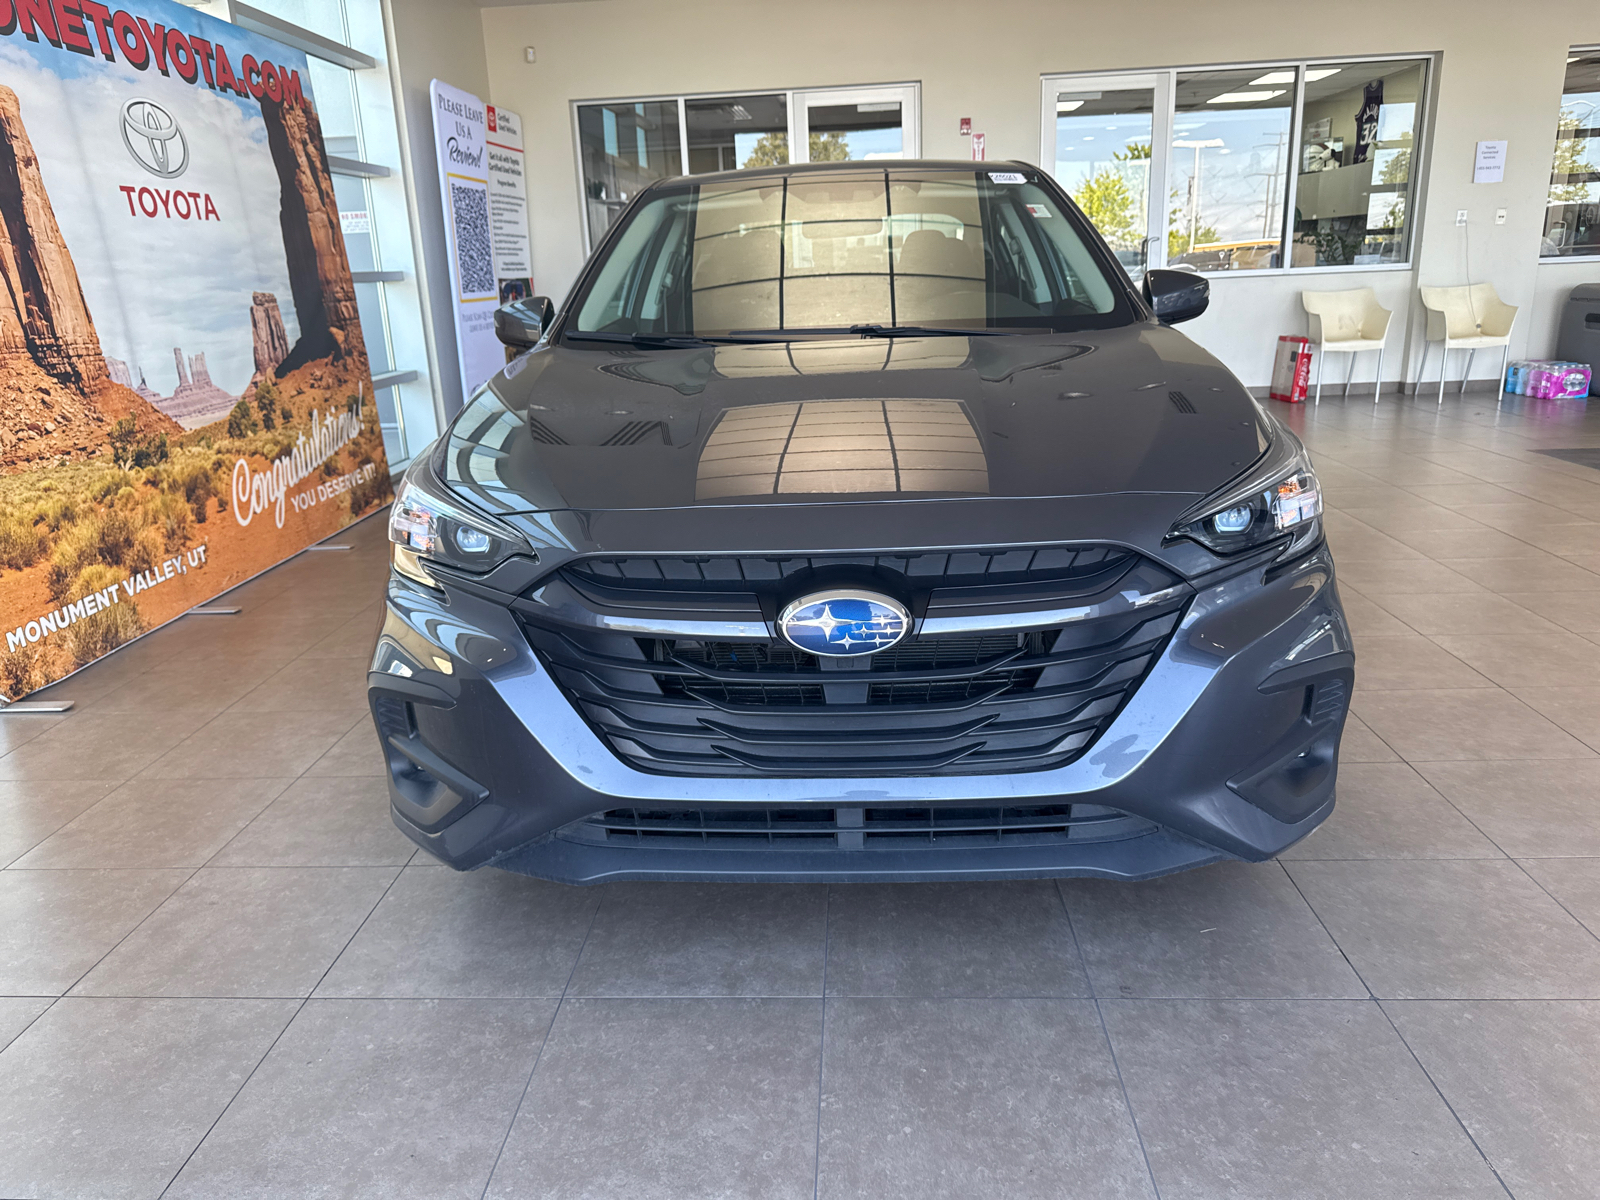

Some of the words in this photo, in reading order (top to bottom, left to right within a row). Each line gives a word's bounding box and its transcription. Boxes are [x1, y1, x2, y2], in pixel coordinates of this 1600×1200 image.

[0, 0, 305, 109] NETOYOTA.COM
[438, 93, 463, 118] PLEASE
[464, 103, 483, 124] LEAVE
[455, 121, 466, 138] US
[467, 125, 473, 141] A
[1360, 122, 1378, 146] 32
[446, 136, 483, 168] Review!
[119, 185, 221, 222] TOYOTA
[232, 380, 365, 529] Congratulations!
[290, 489, 316, 513] YOU
[317, 468, 364, 502] DESERVE
[362, 462, 377, 482] IT!
[6, 583, 120, 653] MONUMENT
[122, 553, 188, 599] VALLEY,
[187, 545, 208, 570] UT
